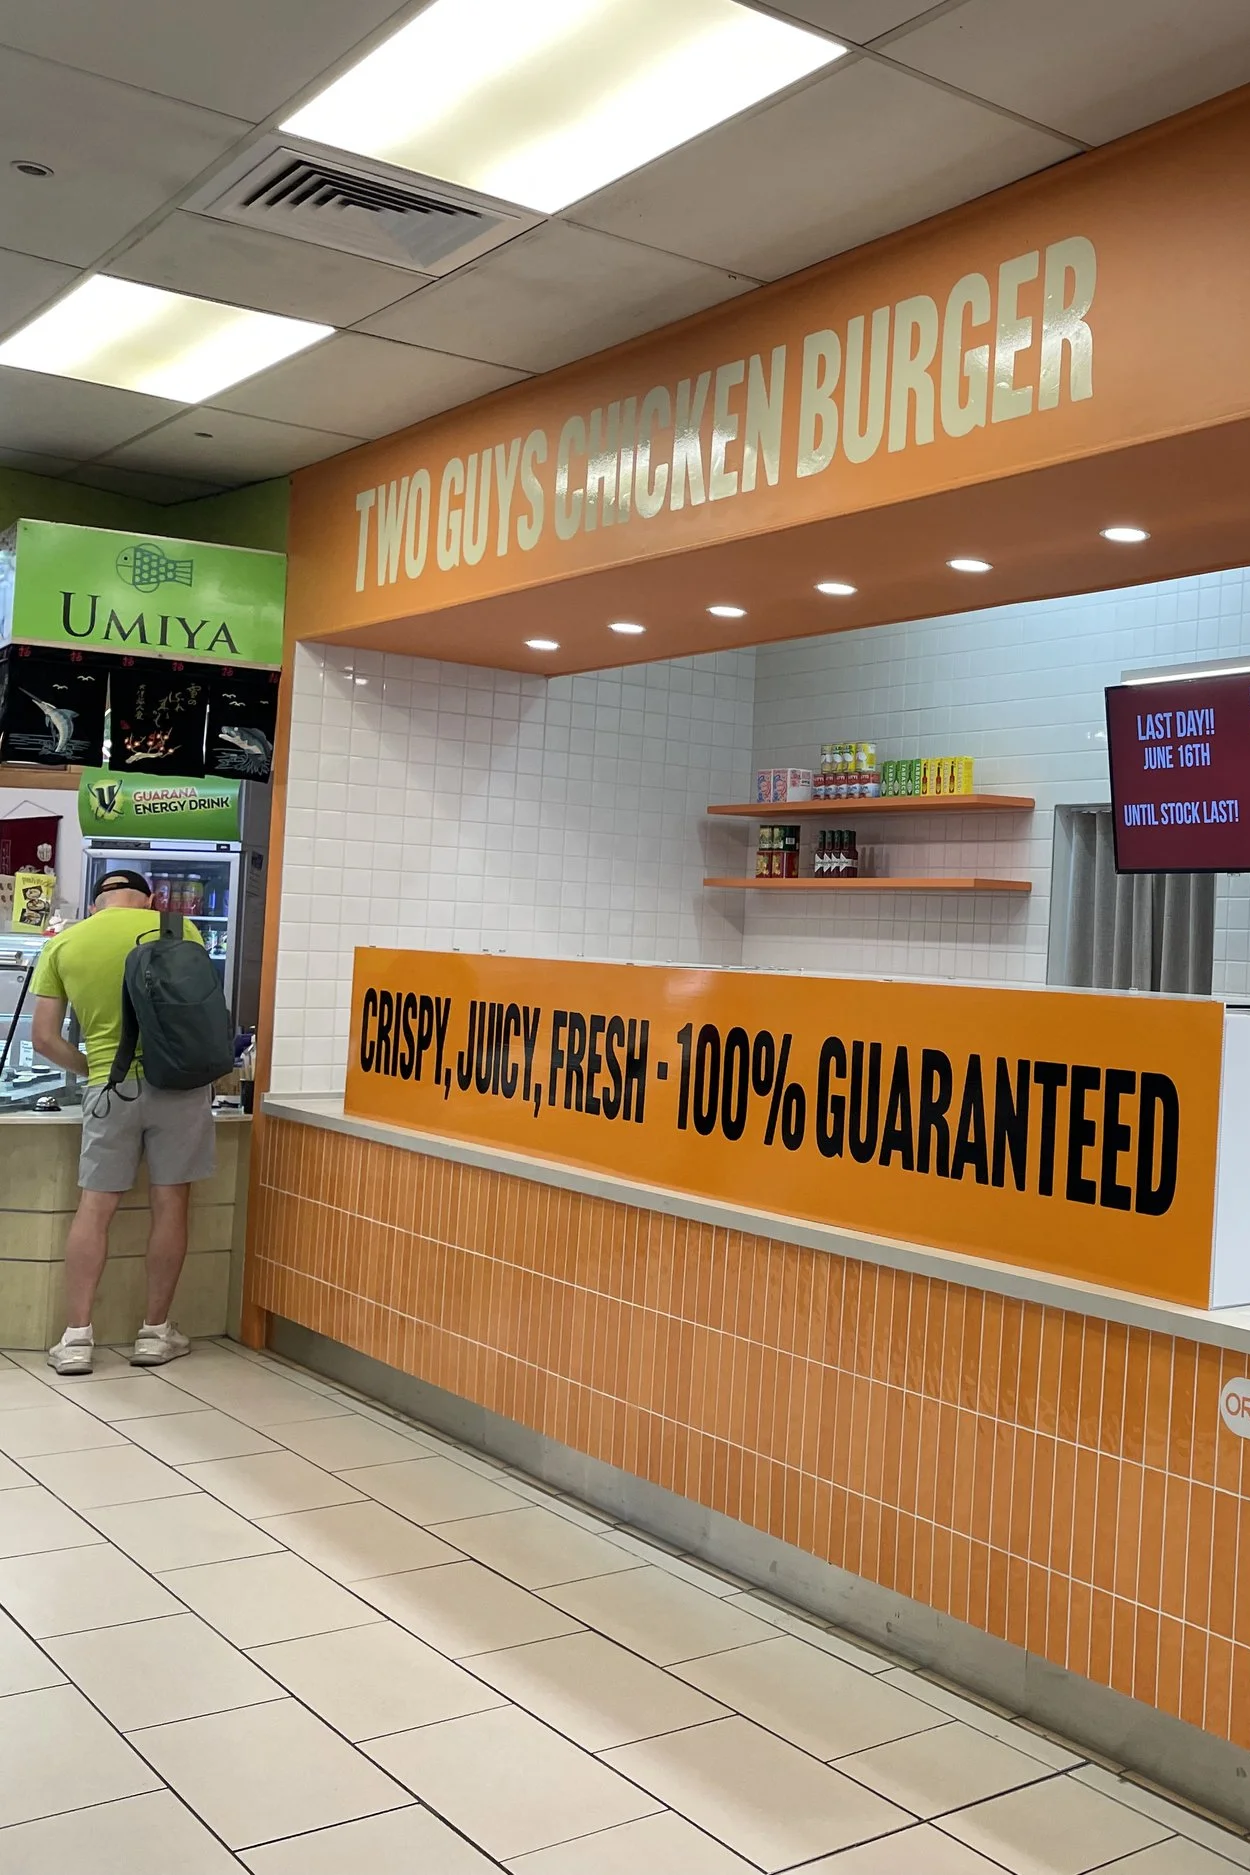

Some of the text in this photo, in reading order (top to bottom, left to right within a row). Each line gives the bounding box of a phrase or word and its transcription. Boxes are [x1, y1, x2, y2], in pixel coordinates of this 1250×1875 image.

[355, 236, 1097, 593] TWO GUYS CHICKEN BURGER
[59, 591, 241, 655] UMIYA
[1136, 708, 1215, 741] LAST DAY!!
[1143, 742, 1211, 770] JUNE 16TH
[133, 788, 197, 802] GUARANA
[134, 797, 230, 815] ENERGY DRINK
[1123, 799, 1240, 827] UNTIL STOCK LAST!
[359, 987, 451, 1100] CRISPY,
[457, 1000, 541, 1119] JUICY,
[548, 1009, 650, 1124] FRESH
[676, 1022, 807, 1151] 100%
[815, 1035, 1181, 1217] GUARANTEED
